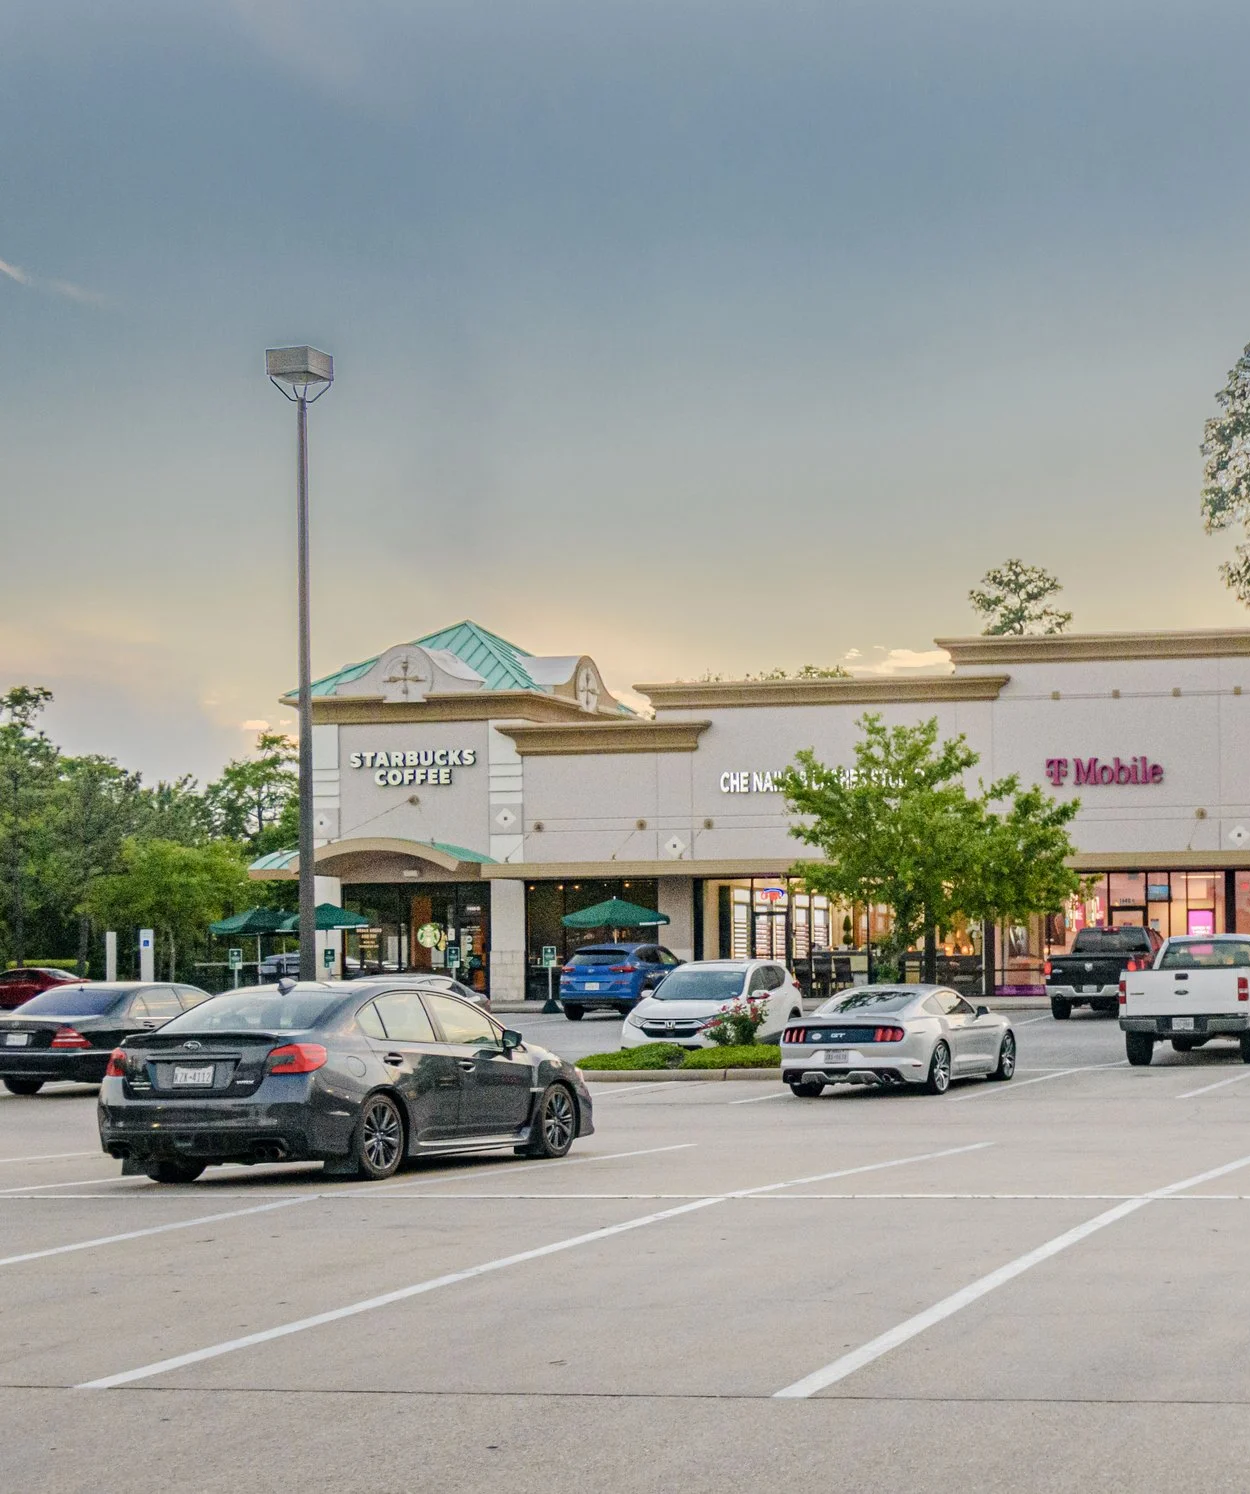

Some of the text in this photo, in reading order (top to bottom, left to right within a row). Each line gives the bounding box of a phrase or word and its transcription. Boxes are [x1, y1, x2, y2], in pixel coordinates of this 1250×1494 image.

[350, 749, 476, 768] STARBUCKS
[374, 768, 452, 786] COFFEE
[1073, 755, 1164, 785] Mobile
[720, 771, 749, 792] CHE
